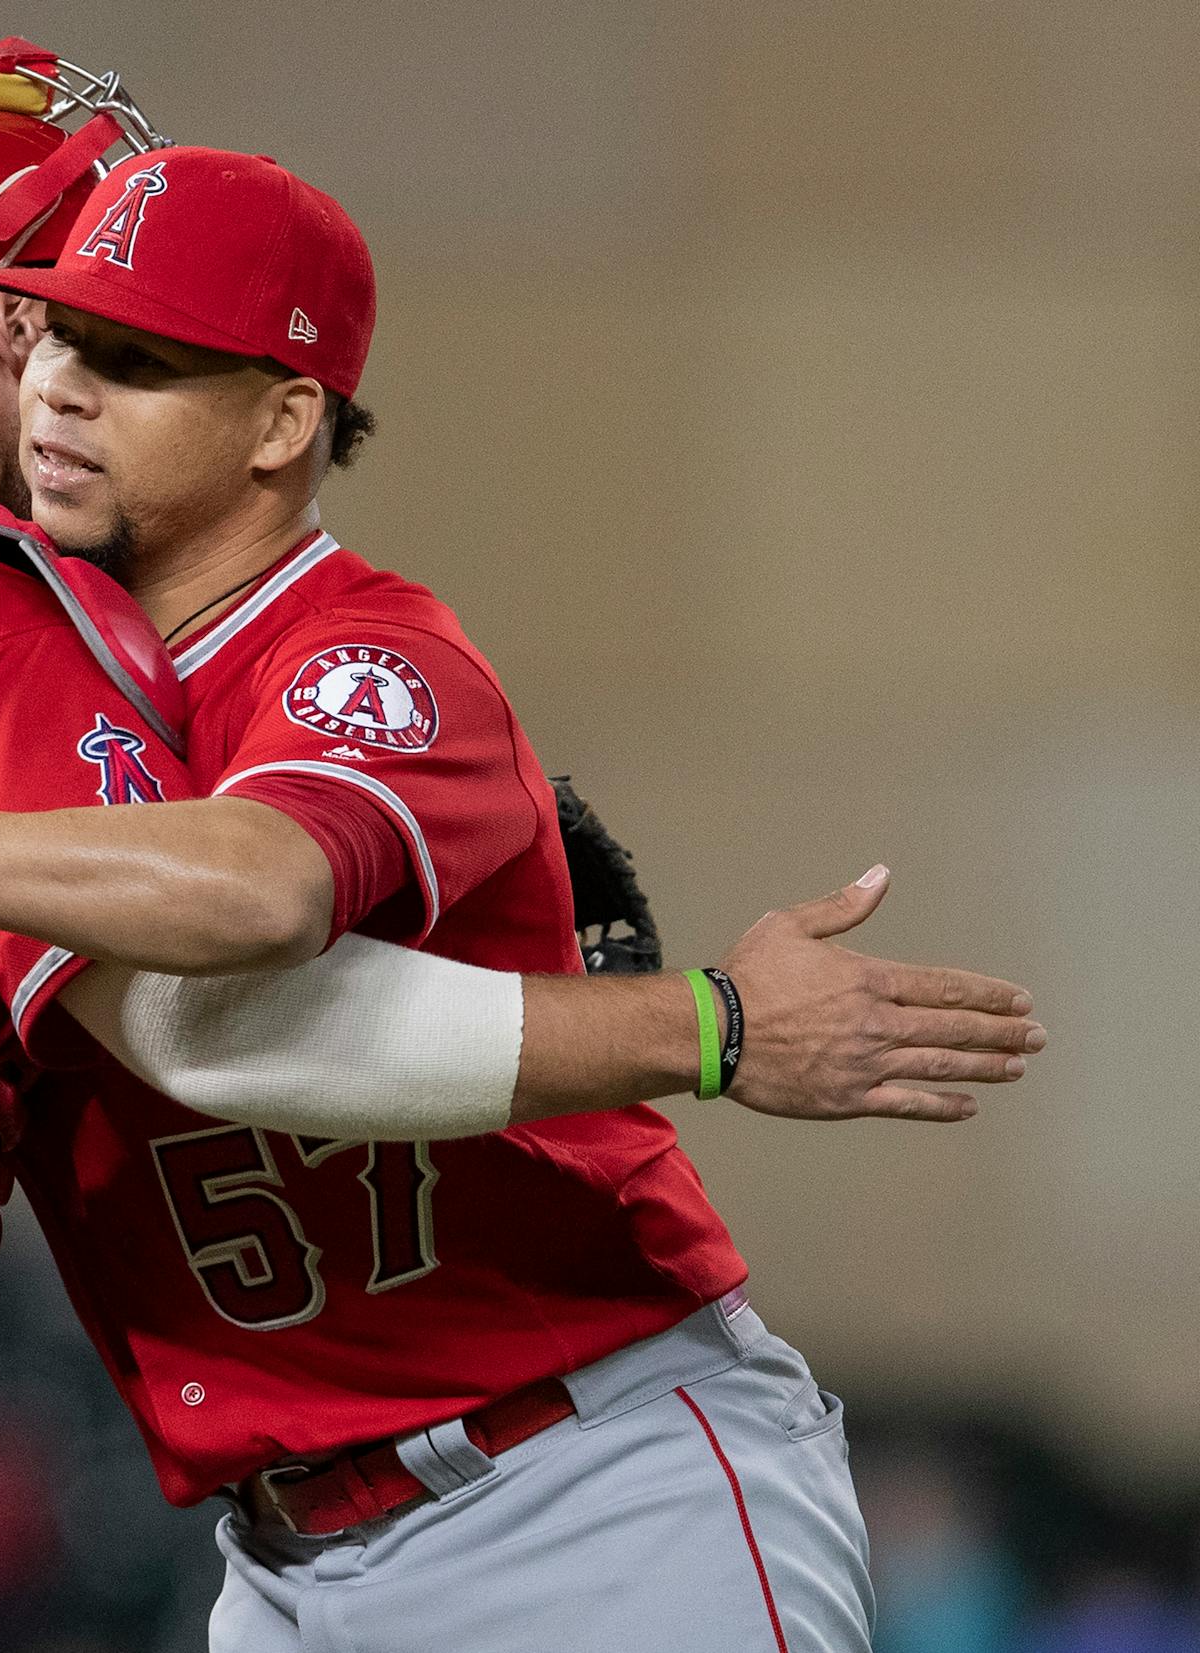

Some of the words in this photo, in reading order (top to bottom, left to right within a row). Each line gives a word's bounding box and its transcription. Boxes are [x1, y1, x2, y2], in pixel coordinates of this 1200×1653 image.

[76, 161, 168, 271] A
[316, 649, 422, 690] ANGELS
[337, 667, 389, 726] A
[296, 705, 424, 746] BASEBALL
[149, 1123, 440, 1331] 57
